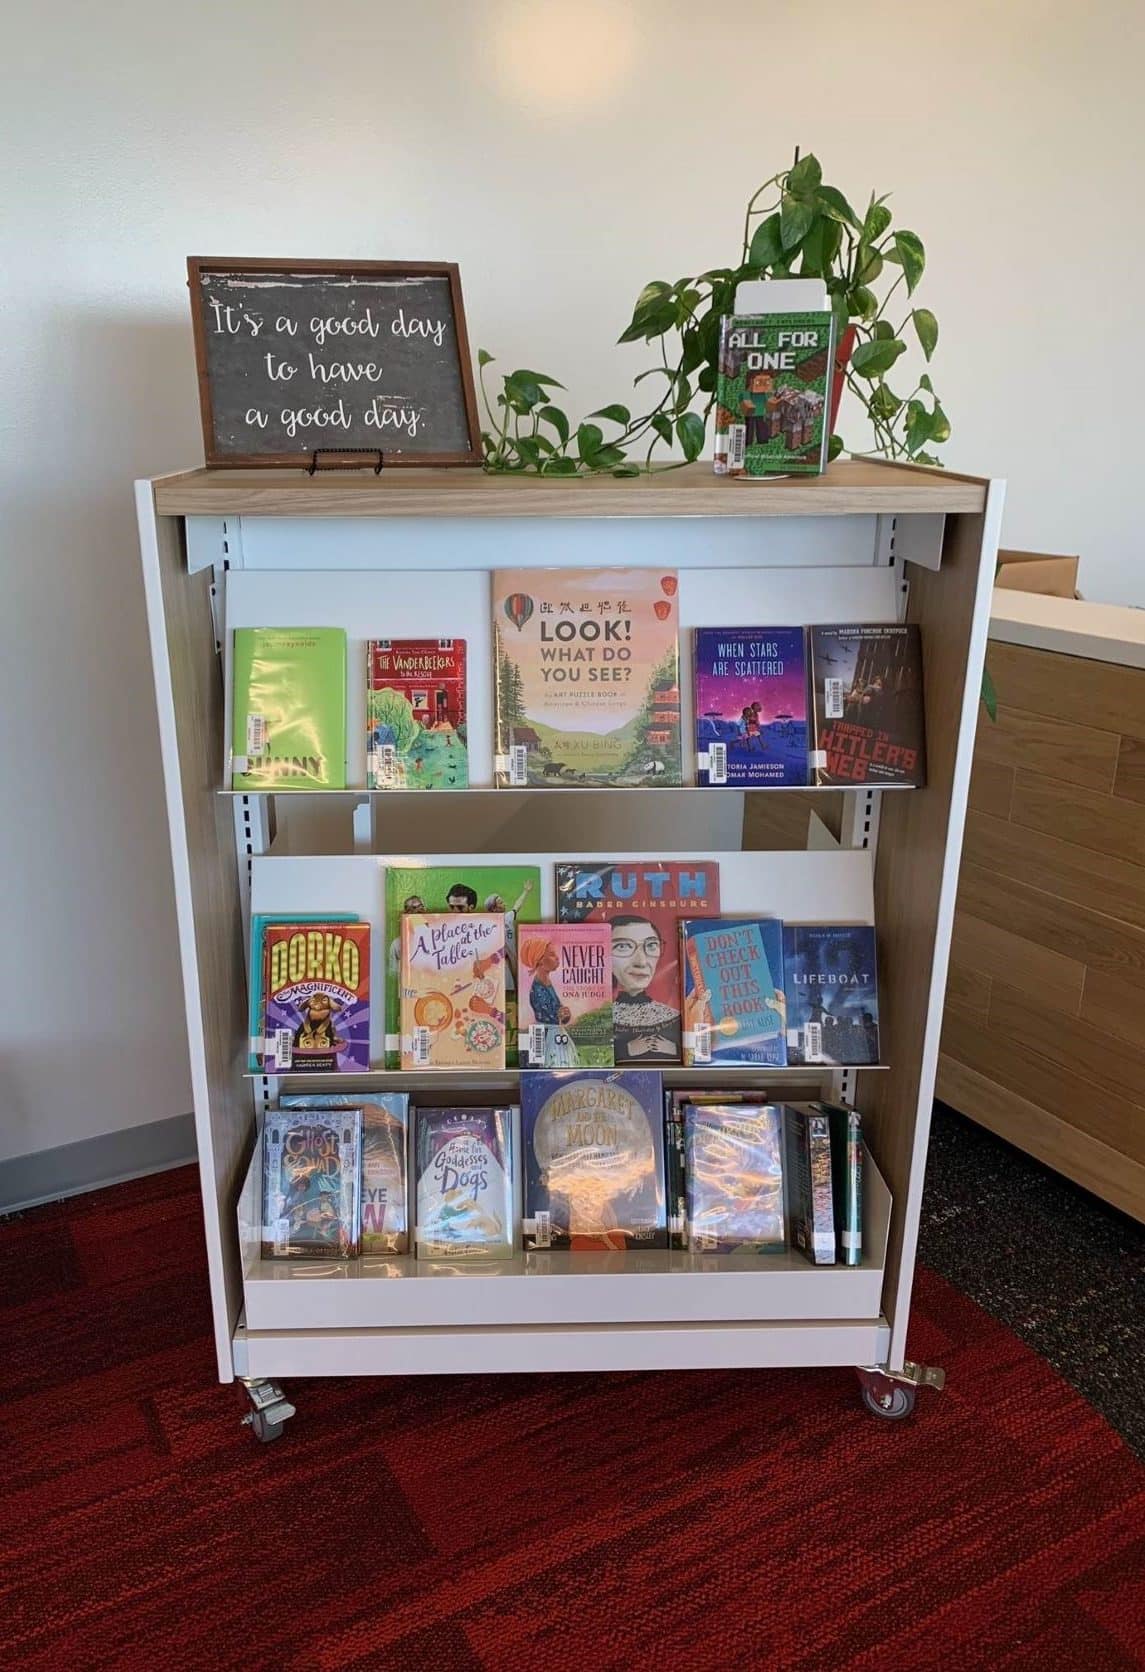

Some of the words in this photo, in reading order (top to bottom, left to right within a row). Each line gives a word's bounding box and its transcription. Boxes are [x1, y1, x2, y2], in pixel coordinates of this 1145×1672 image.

[210, 300, 263, 336] It's
[275, 316, 298, 336] a
[310, 308, 380, 345] good
[391, 309, 446, 346] day
[728, 332, 766, 348] ALL
[778, 331, 818, 347] FOR
[264, 353, 298, 381] to
[309, 353, 382, 383] have
[747, 352, 796, 370] ONE
[245, 408, 268, 428] a
[281, 399, 352, 437] good
[364, 399, 426, 437] day.
[541, 620, 631, 641] LOOK!
[540, 647, 595, 662] WHAT
[603, 647, 631, 661] DO
[718, 643, 744, 657] WHEN
[750, 642, 778, 657] STARS
[377, 655, 390, 670] THE
[392, 655, 455, 671] VANDERBEEKERS
[540, 668, 580, 682] YOU
[588, 667, 632, 682] SEE?
[712, 661, 729, 676] ARE
[735, 661, 784, 677] SCATTERED
[820, 729, 917, 770] HITLER'S
[827, 752, 869, 781] WEB
[575, 872, 706, 899] RUTH
[460, 931, 473, 945] at
[473, 923, 497, 941] the
[704, 928, 753, 951] DON'T
[409, 936, 430, 962] A
[431, 942, 473, 970] Table
[562, 945, 605, 968] NEVER
[705, 945, 760, 969] CHECK
[271, 931, 361, 992] DORKO
[562, 967, 604, 985] CAUGHT
[721, 964, 752, 983] OUT
[793, 973, 870, 985] LIFEBOAT
[290, 982, 355, 1001] MAGNIFICENT
[720, 979, 760, 1003] THIS
[551, 1087, 634, 1121] MARGARET
[566, 1123, 617, 1146] MOON
[435, 1152, 488, 1170] Goddesses
[434, 1166, 488, 1201] Dogs
